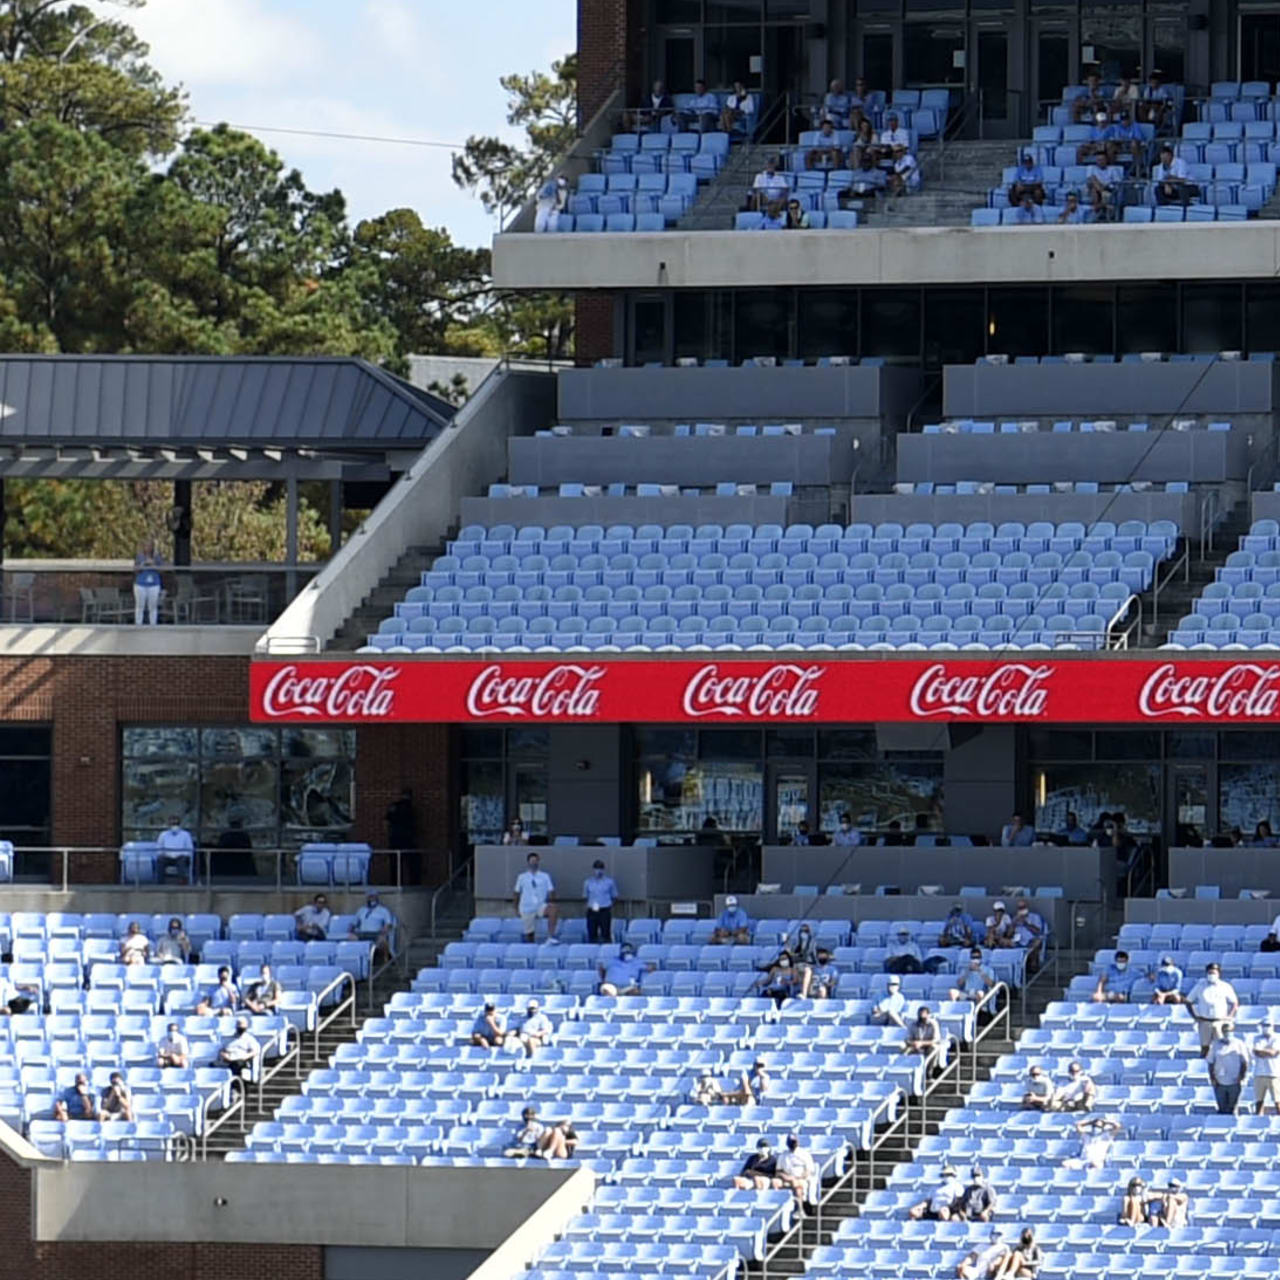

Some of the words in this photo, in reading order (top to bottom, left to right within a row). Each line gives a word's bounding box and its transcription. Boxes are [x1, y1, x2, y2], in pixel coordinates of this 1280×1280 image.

[262, 664, 402, 718] Coca-Cola
[466, 664, 609, 718] Coca-Cola
[682, 664, 827, 718] Coca-Cola
[909, 663, 1057, 718] Coca-Cola
